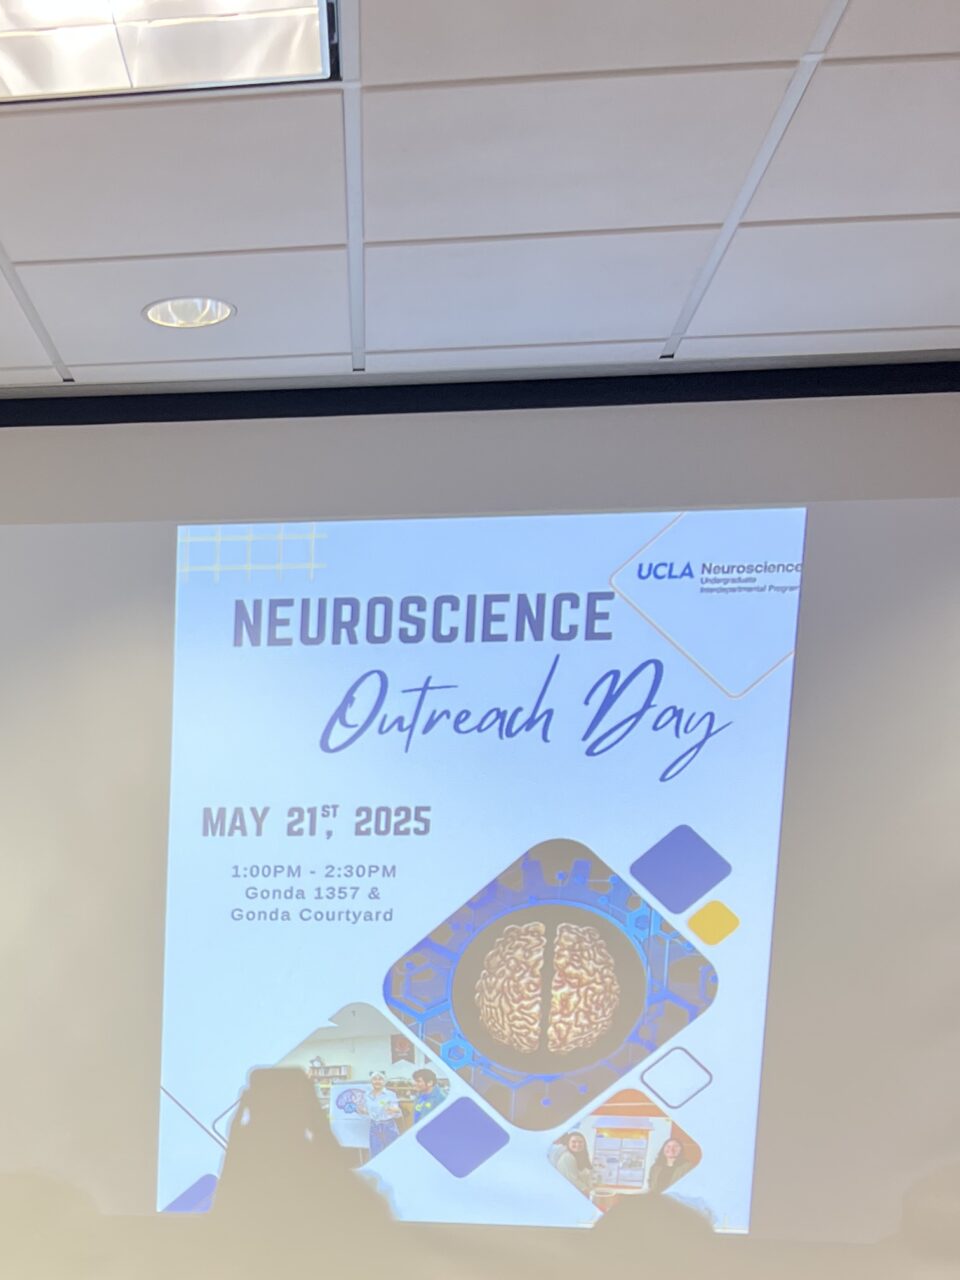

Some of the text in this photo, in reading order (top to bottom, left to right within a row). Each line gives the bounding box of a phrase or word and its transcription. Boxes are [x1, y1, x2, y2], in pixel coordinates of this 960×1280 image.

[637, 560, 803, 580] UCLA Neuroscience
[232, 590, 616, 648] NEUROSCIENCE
[318, 653, 734, 783] Outreach Day
[201, 806, 271, 838] MAY
[353, 805, 432, 837] 2025
[230, 864, 303, 879] 1:00PM
[323, 864, 398, 879] 2:30PM
[244, 886, 382, 901] Gonda 1357 &
[230, 907, 395, 925] Gonda Courtyard
